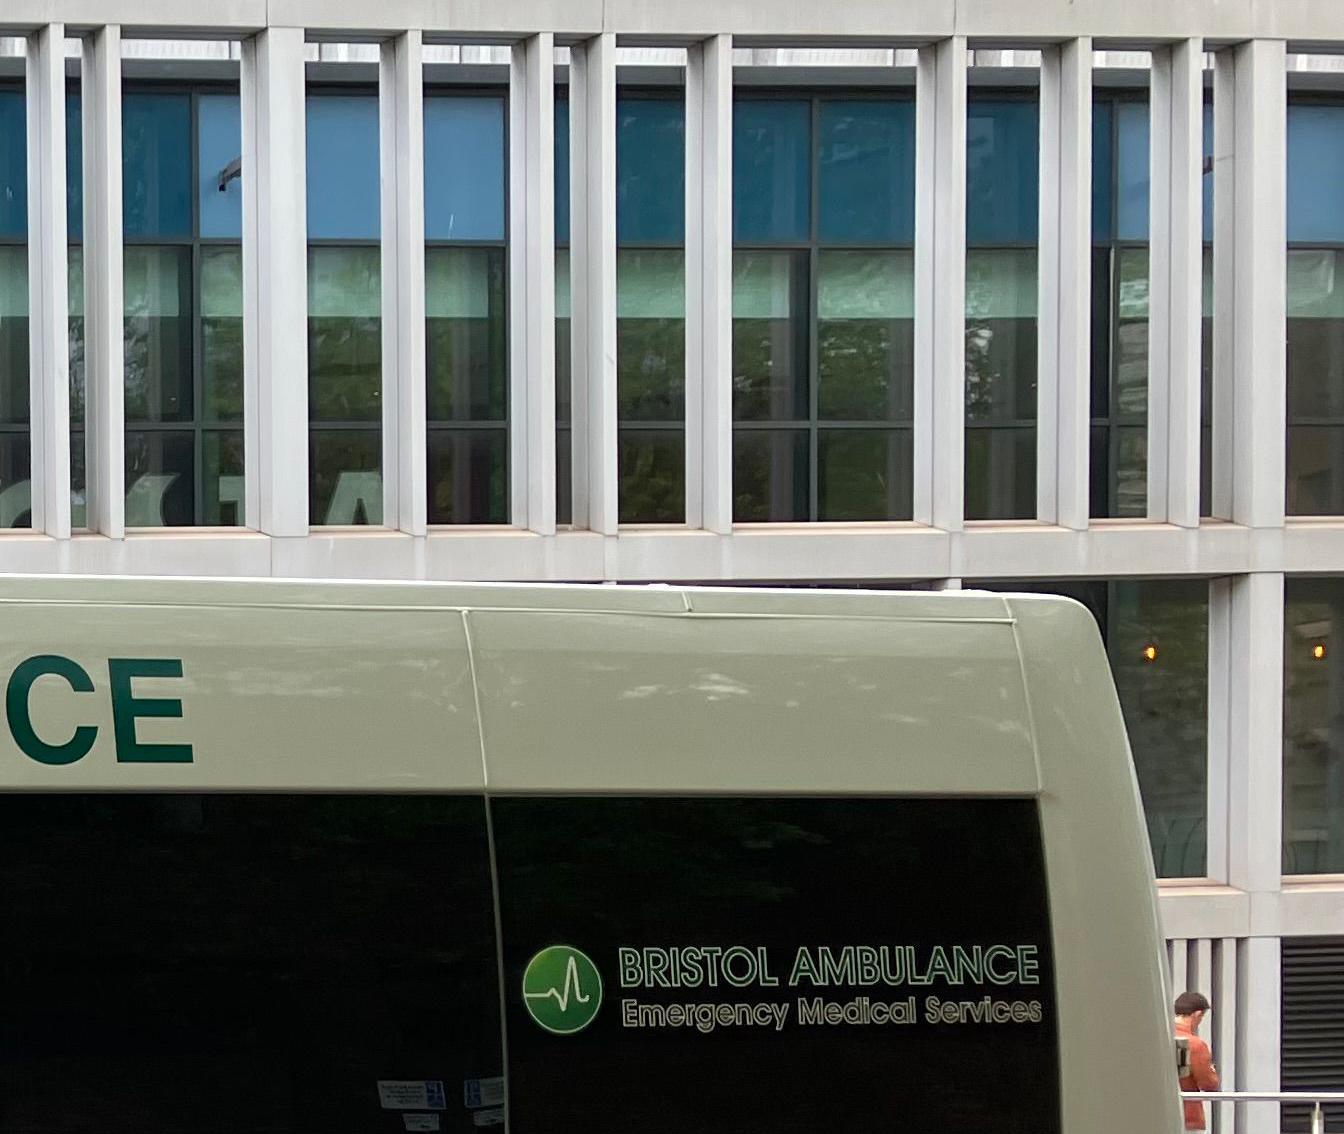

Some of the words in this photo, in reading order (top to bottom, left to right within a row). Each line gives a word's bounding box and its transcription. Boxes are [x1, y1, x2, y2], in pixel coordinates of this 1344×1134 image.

[617, 944, 780, 988] BRISTOL
[788, 944, 1041, 986] AMBULANCE
[621, 998, 790, 1032] Emergency
[798, 996, 917, 1025] Medical
[924, 995, 1042, 1024] Services
